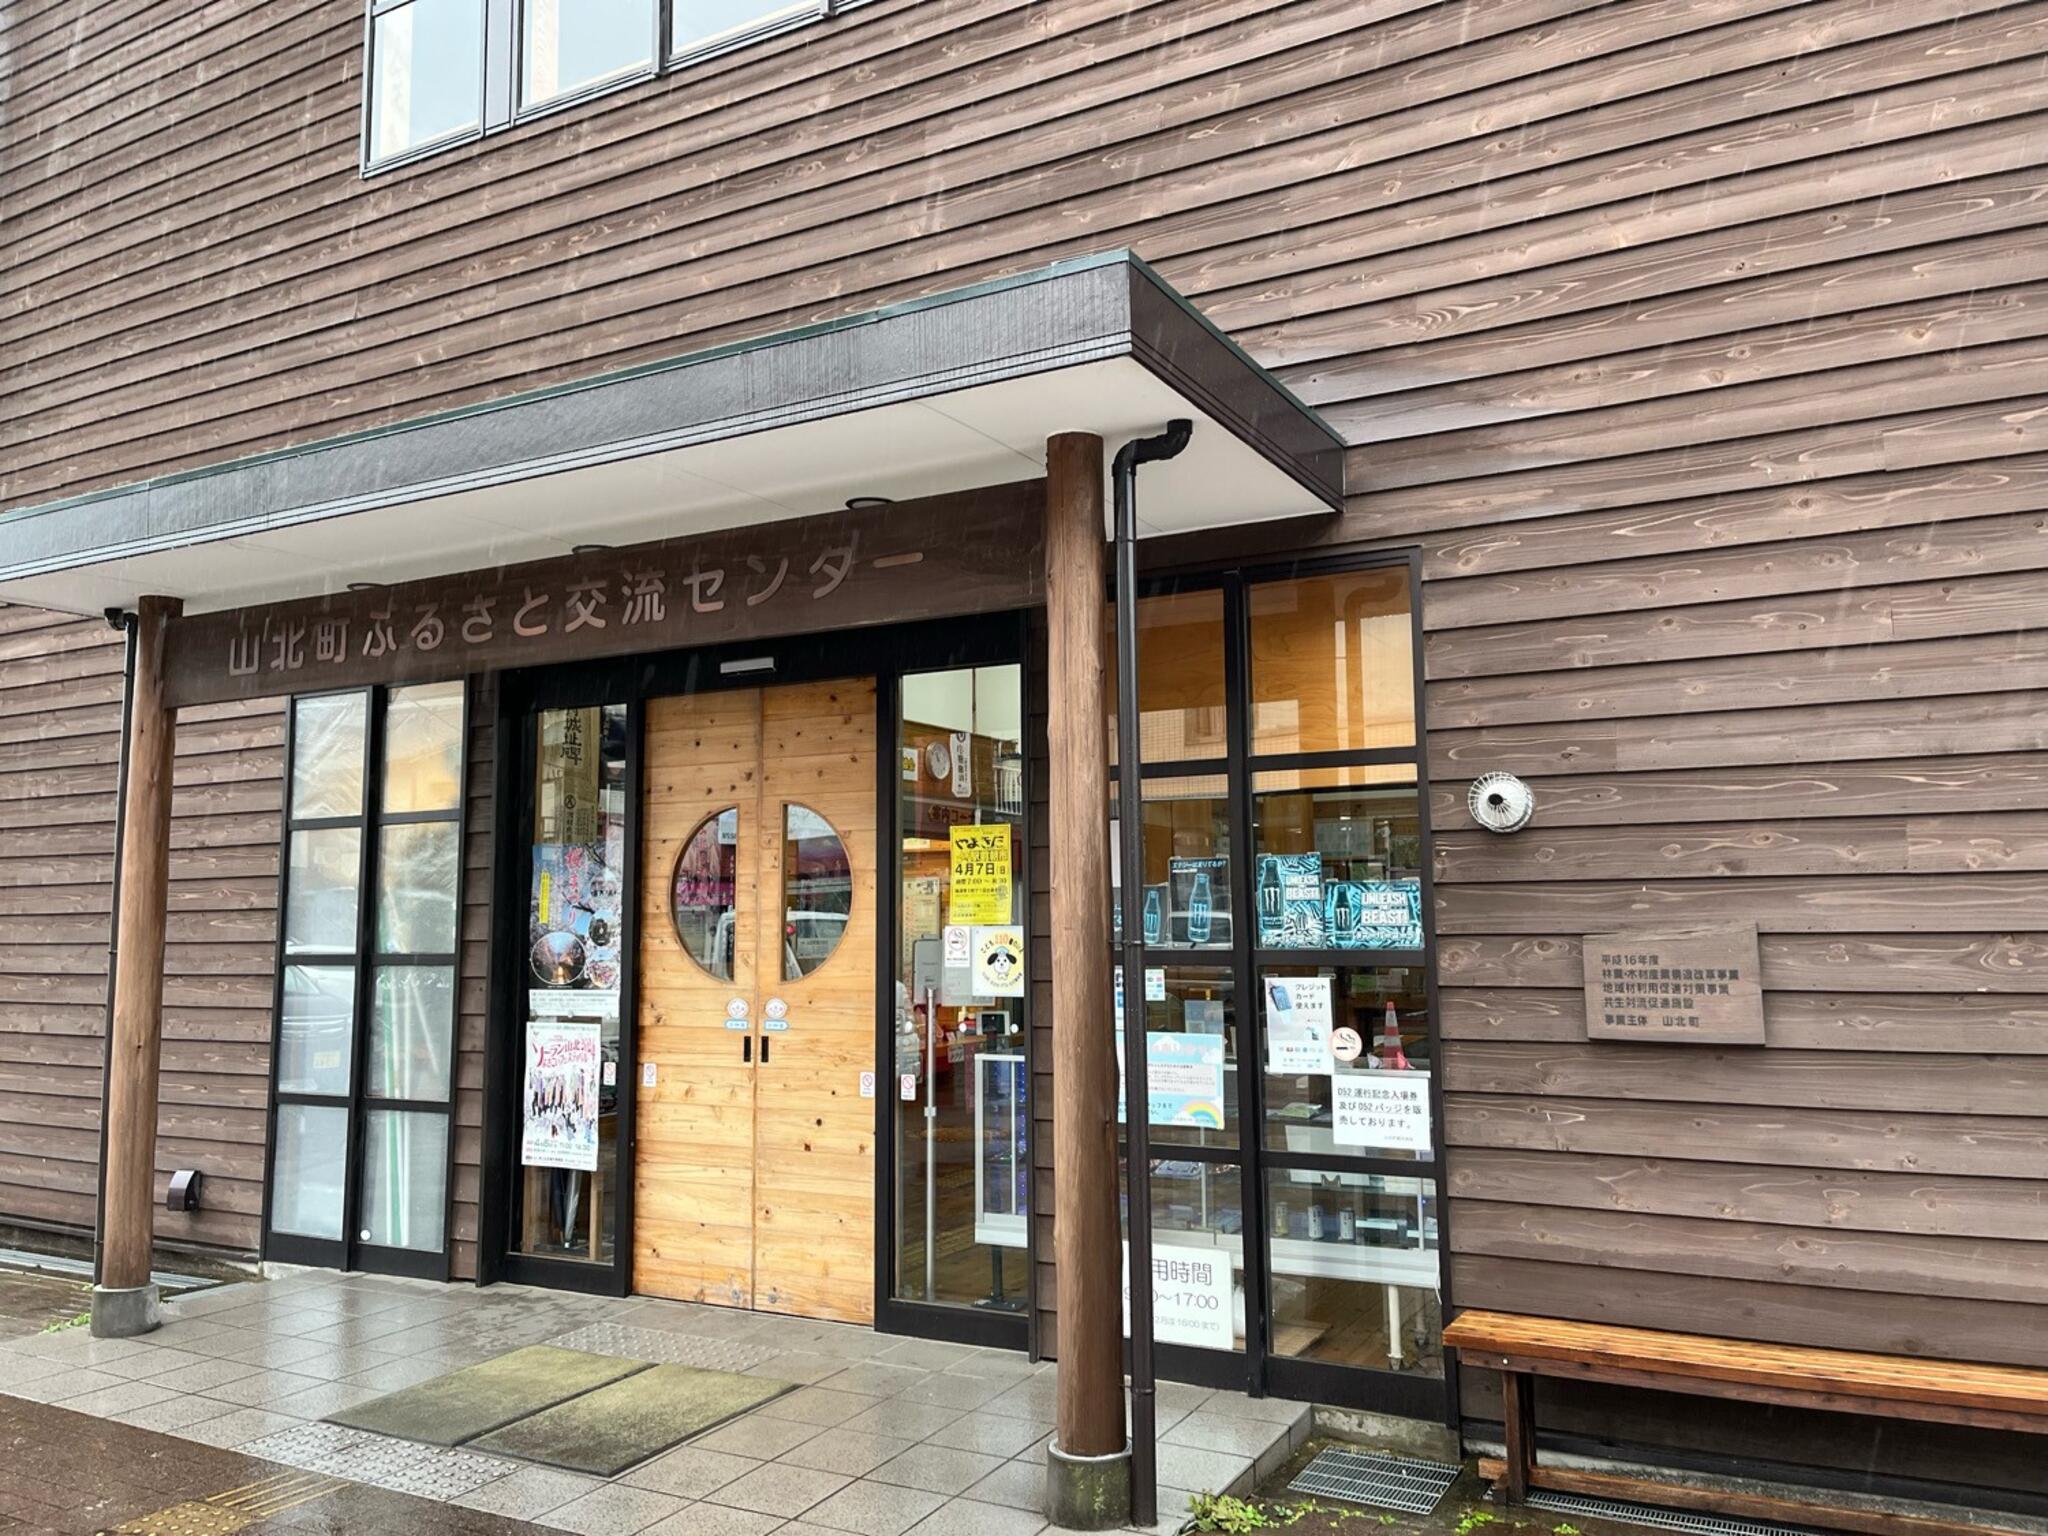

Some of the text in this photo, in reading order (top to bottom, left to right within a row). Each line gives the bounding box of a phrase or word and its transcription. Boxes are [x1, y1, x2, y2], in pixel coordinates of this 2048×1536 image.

[229, 531, 925, 677] 山北町ふるさと交流センター
[1362, 892, 1407, 905] UNLEASH
[1362, 910, 1409, 924] BEAST!
[1601, 954, 1660, 966] 平成16年度
[1295, 983, 1327, 992] クレジット
[1295, 1002, 1324, 1010] 使えます
[1605, 1014, 1700, 1028] 事業主体 山北町
[1339, 1115, 1411, 1129] 売しております。
[1152, 1258, 1212, 1286] 用時間
